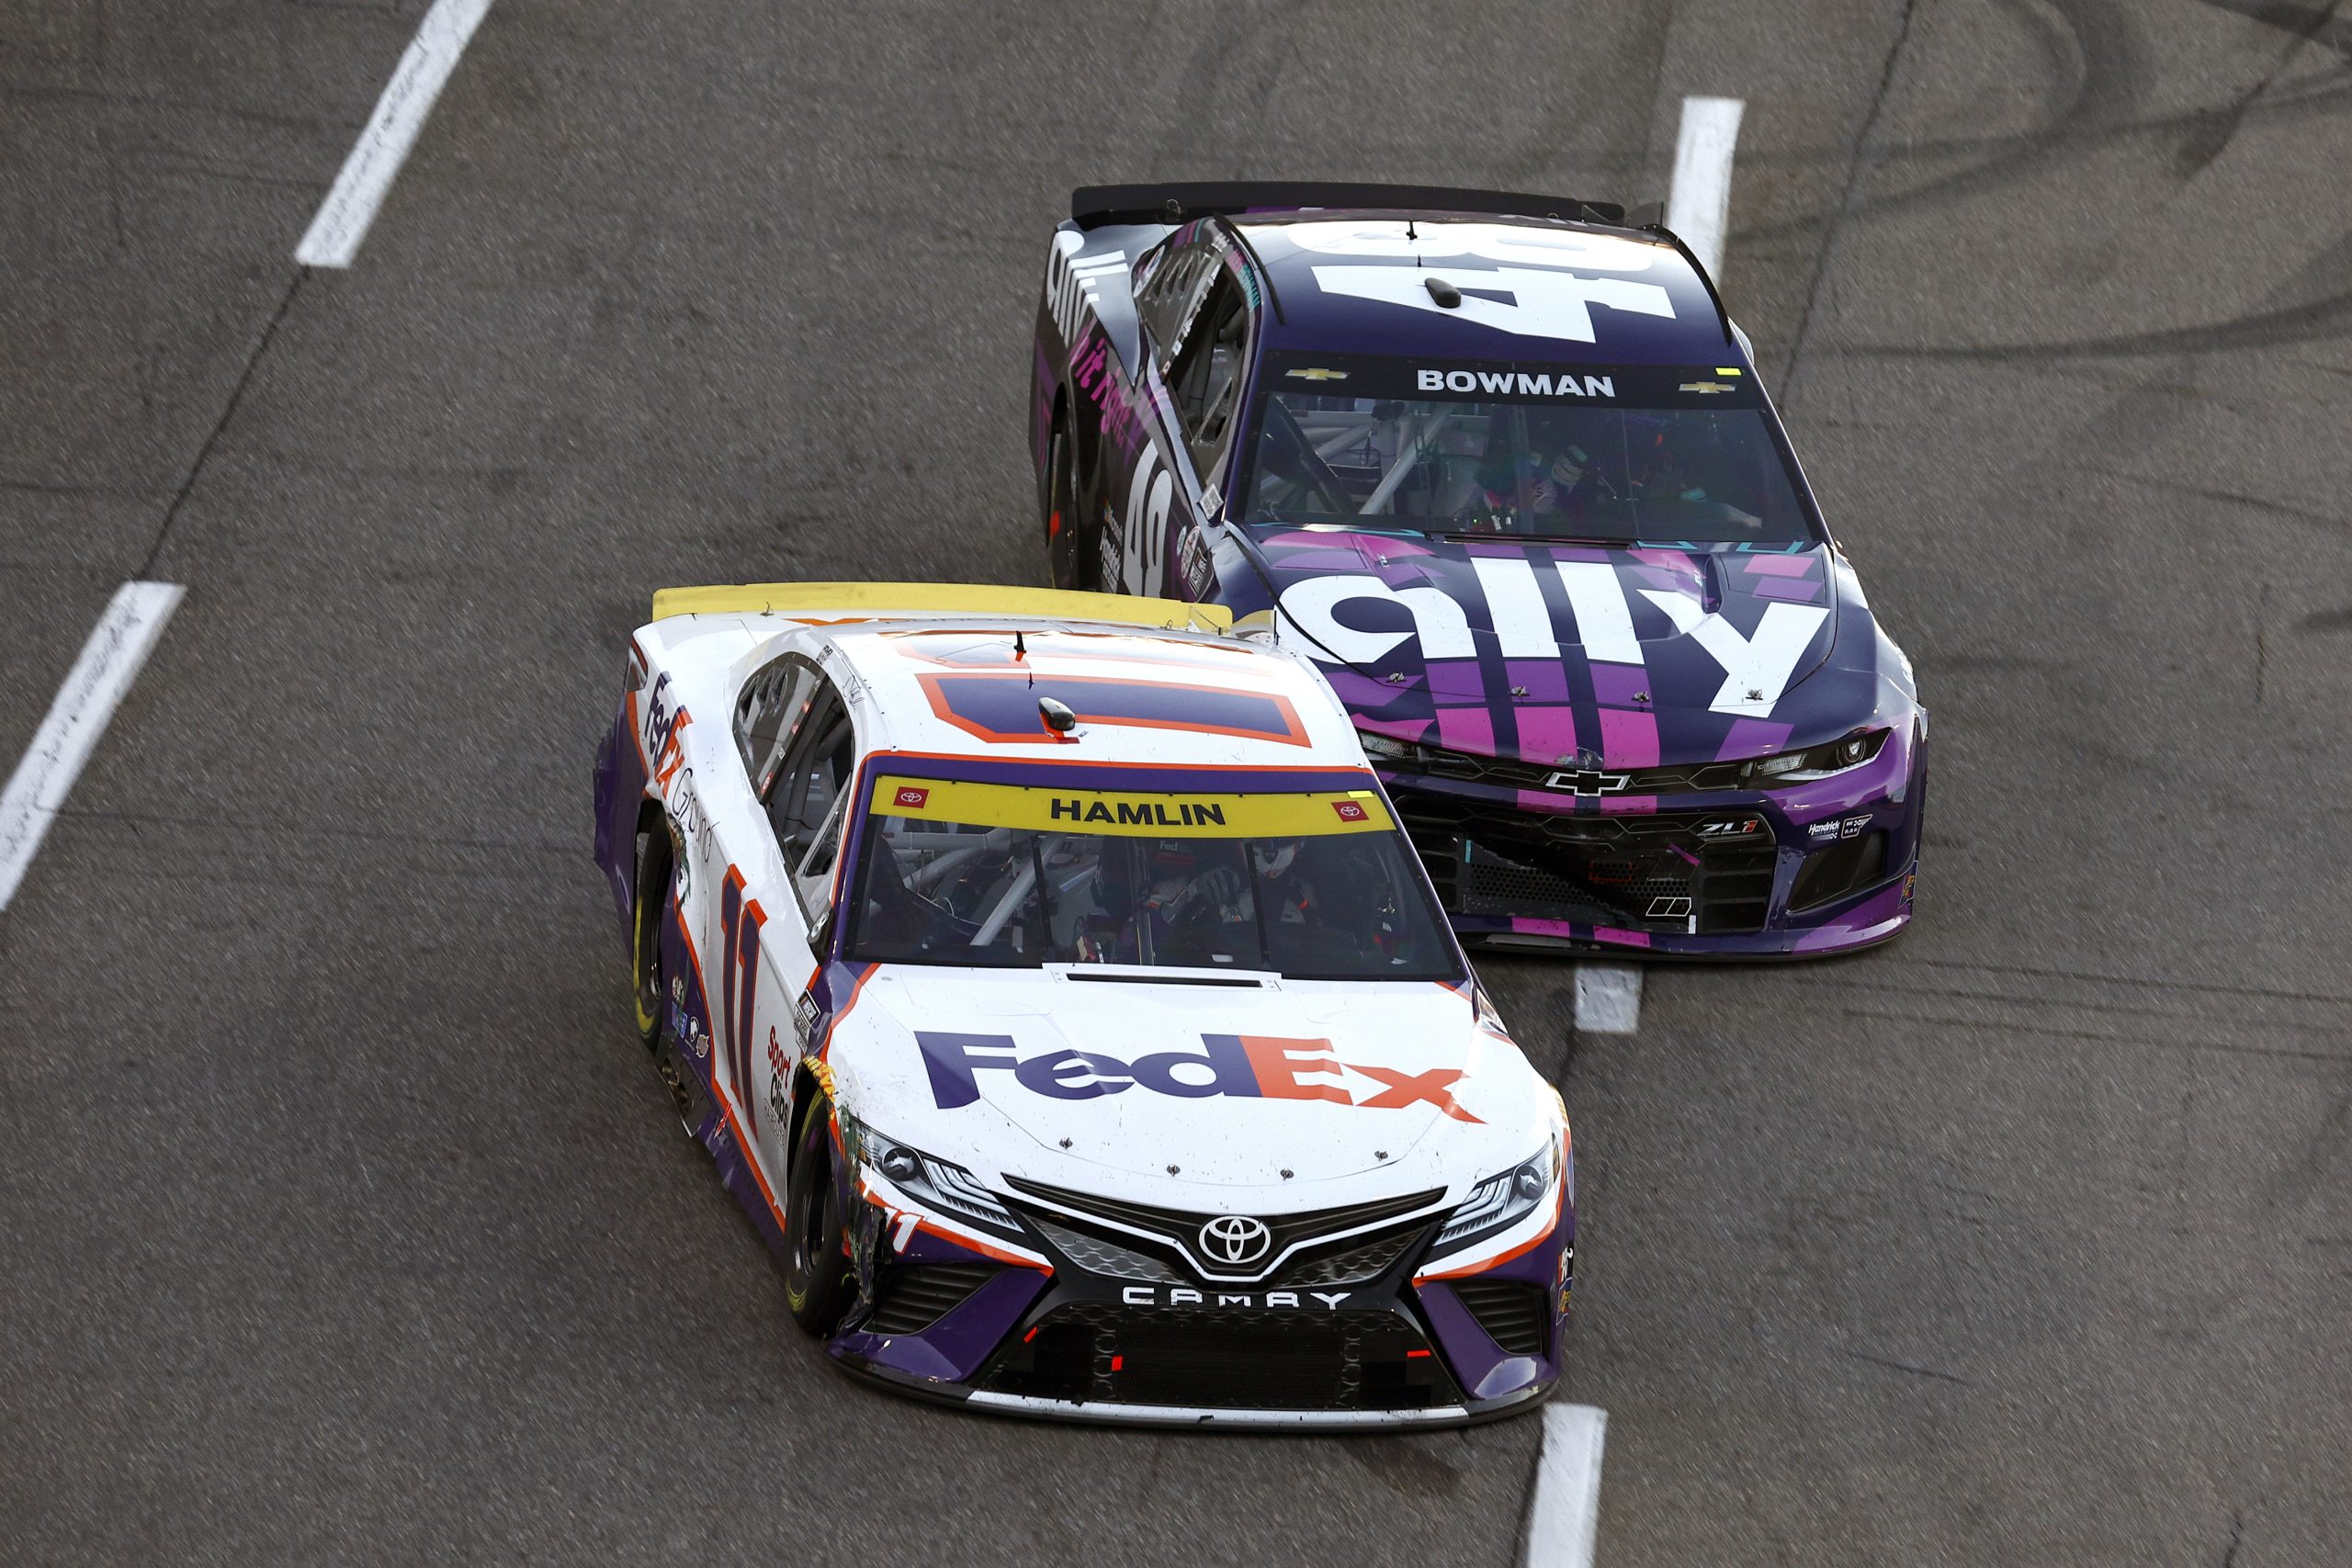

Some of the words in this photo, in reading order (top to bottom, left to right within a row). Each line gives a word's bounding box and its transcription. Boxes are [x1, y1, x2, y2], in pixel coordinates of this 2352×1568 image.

[1417, 368, 1615, 398] BOWMAN
[1123, 439, 1172, 598] 48
[1279, 558, 1829, 718] ally
[644, 671, 694, 801] FedEx
[1050, 798, 1226, 827] HAMLIN
[1698, 820, 1758, 837] ZL1
[1808, 819, 1840, 836] Hendrick
[720, 863, 767, 1144] 11
[767, 1025, 791, 1089] Sport
[912, 1032, 1486, 1125] FedEx
[771, 1073, 789, 1130] Clips
[1122, 1286, 1351, 1310] CAMRY
